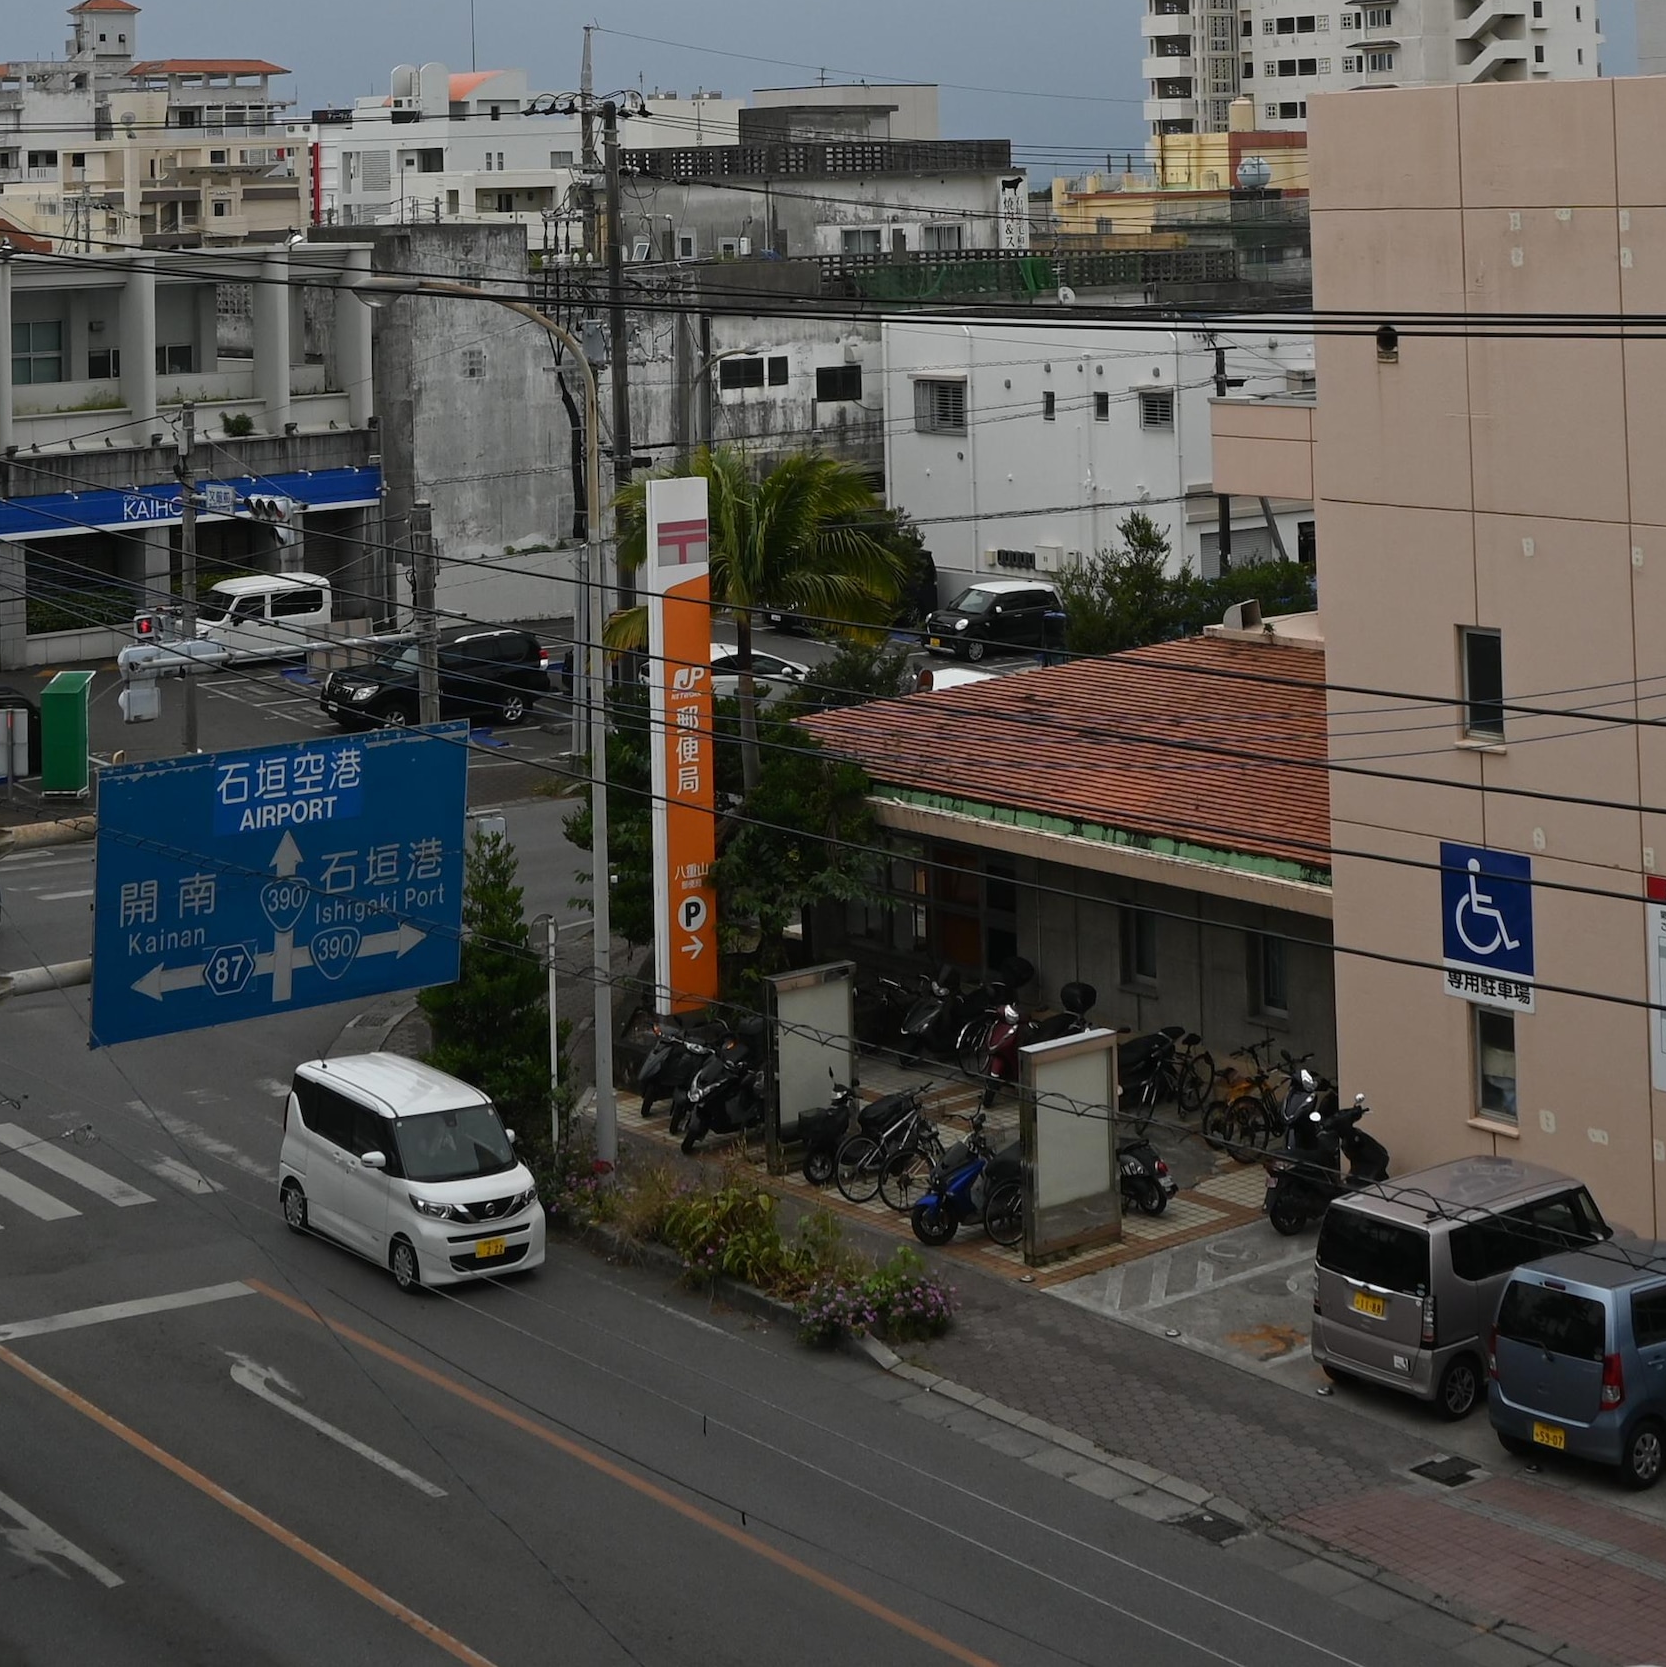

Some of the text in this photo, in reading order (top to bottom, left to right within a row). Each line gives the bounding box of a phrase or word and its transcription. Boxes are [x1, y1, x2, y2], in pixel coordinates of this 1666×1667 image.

[676, 705, 700, 796] 郵便局
[216, 747, 362, 805] 石垣空港
[239, 796, 338, 832] AIRPORT
[319, 836, 443, 895] 石垣港
[267, 885, 303, 913] 390
[315, 882, 445, 926] Ishigaki Port
[685, 901, 701, 927] P
[128, 927, 206, 957] Kainan
[317, 936, 353, 962] 390
[214, 955, 245, 985] 87
[1447, 969, 1531, 1005] 専用駐車場
